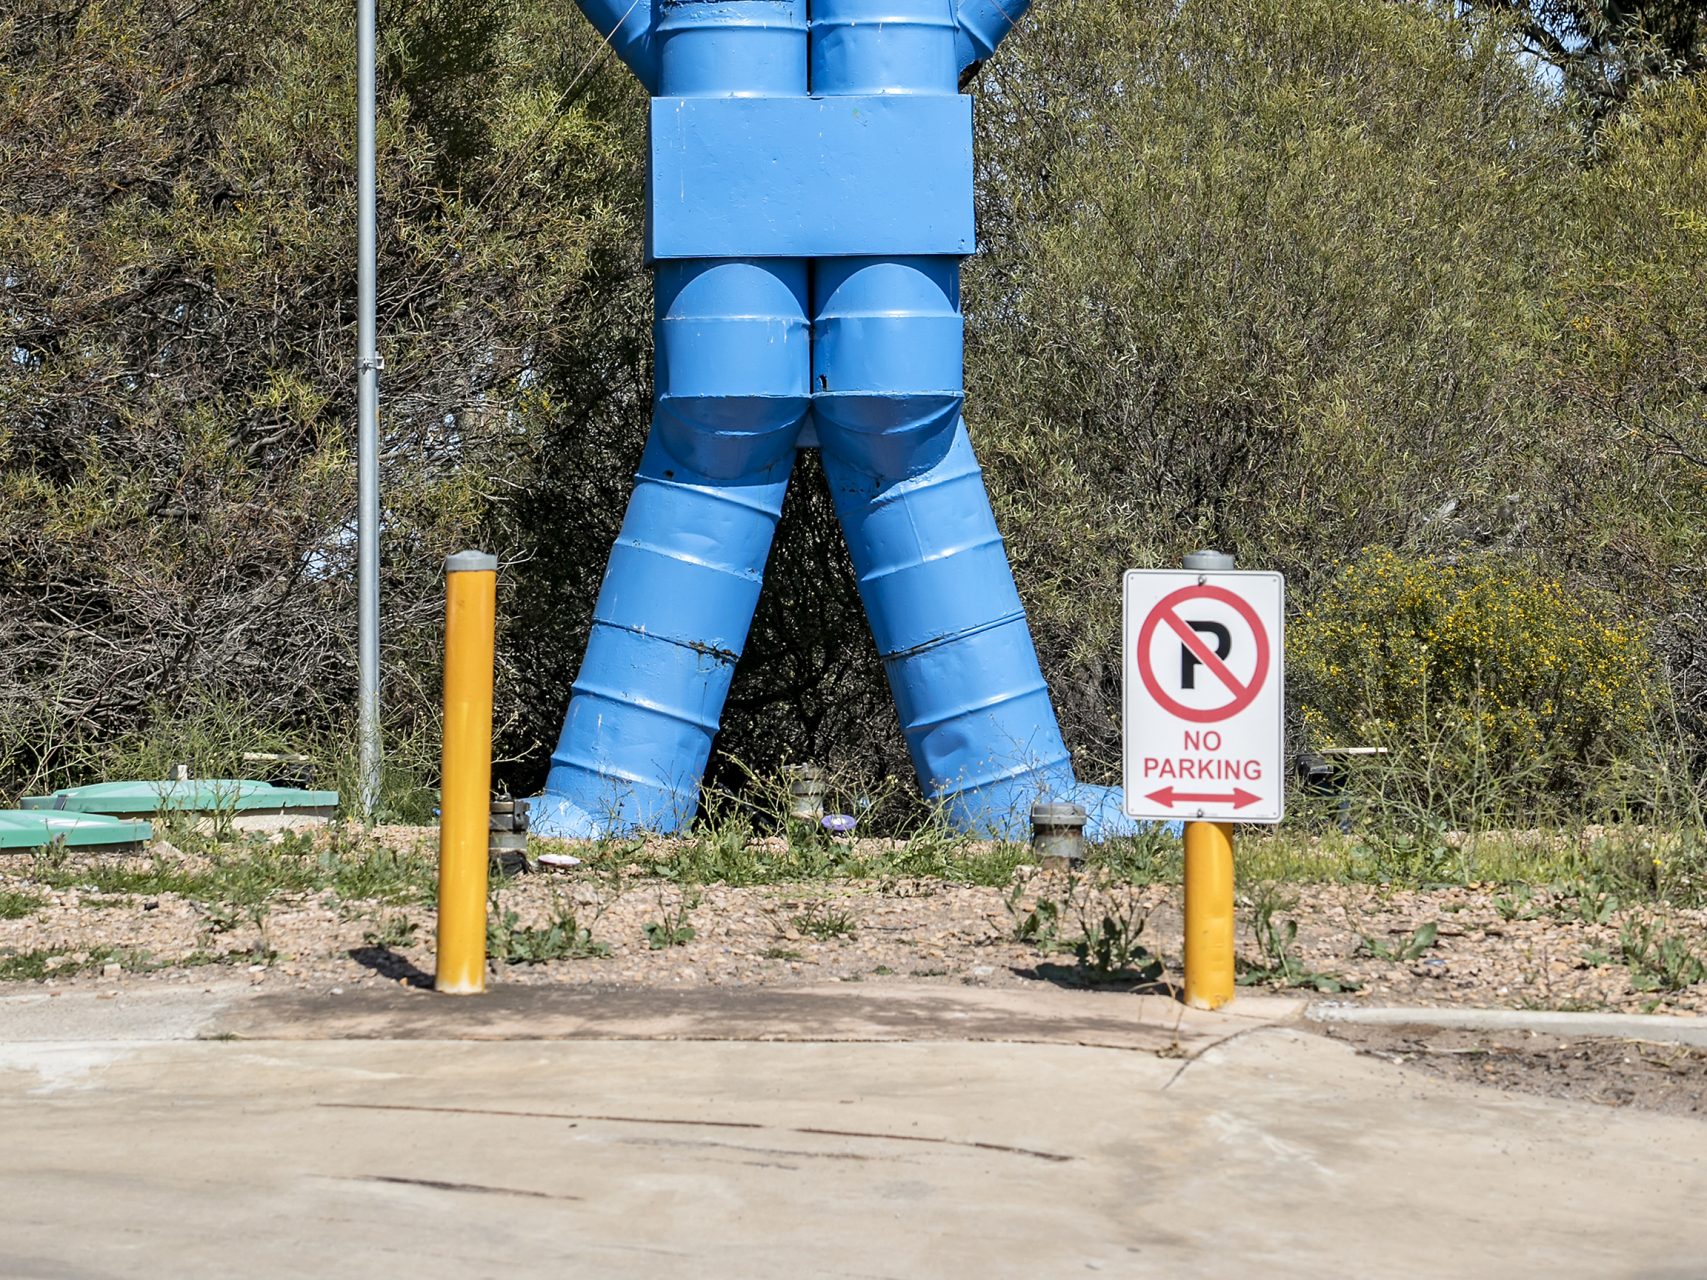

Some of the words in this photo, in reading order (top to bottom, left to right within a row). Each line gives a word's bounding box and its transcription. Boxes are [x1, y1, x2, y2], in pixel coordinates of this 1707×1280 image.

[1181, 620, 1231, 689] P
[1184, 730, 1221, 751] NO
[1144, 757, 1262, 780] PARKING
